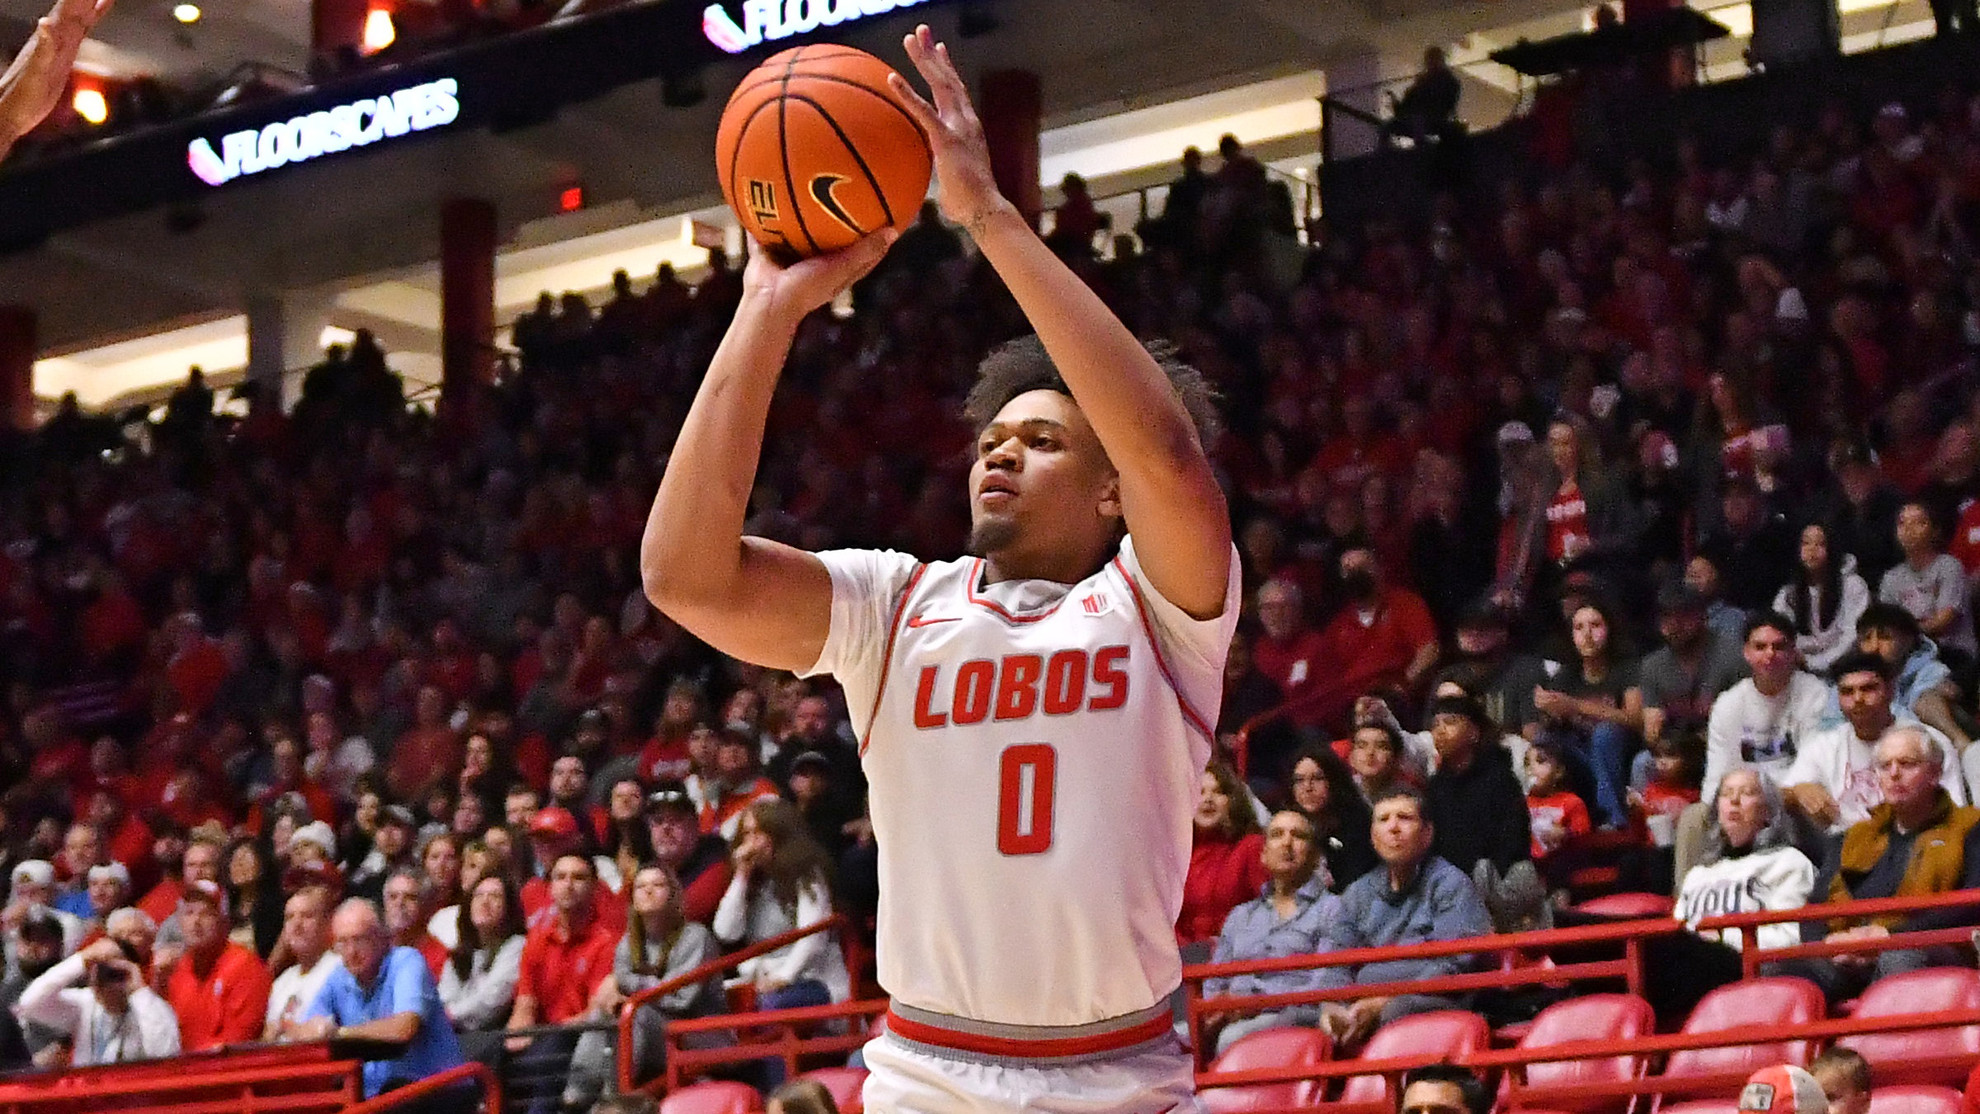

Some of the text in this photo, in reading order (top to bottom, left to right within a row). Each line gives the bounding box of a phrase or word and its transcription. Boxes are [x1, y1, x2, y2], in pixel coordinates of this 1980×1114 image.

[222, 78, 459, 177] FLOORSCAPES
[914, 645, 1131, 731] LOBOS
[997, 742, 1058, 857] 0
